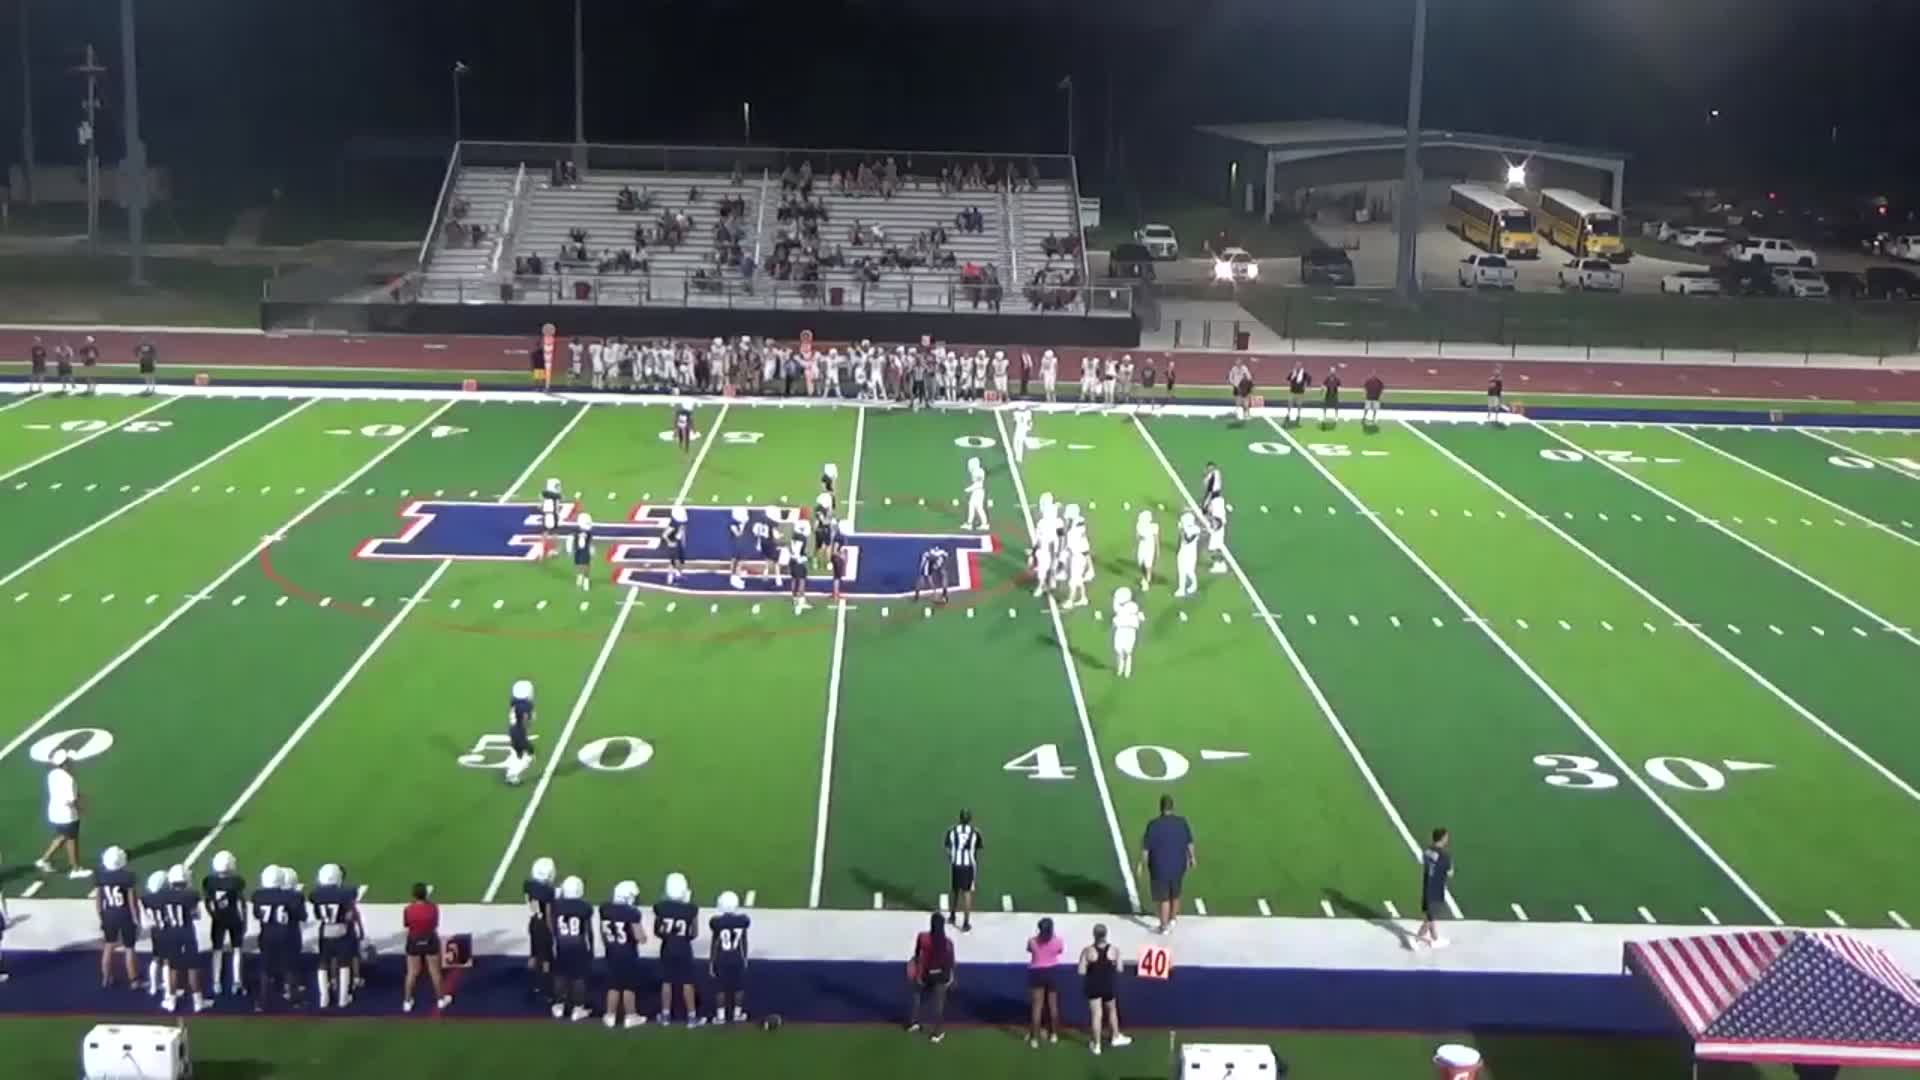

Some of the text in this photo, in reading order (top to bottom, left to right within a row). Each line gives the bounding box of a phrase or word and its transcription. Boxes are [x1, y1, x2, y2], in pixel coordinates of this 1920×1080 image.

[1003, 743, 1190, 780] 40
[1532, 753, 1726, 791] 30
[260, 904, 289, 924] 76
[1141, 949, 1166, 976] 40
